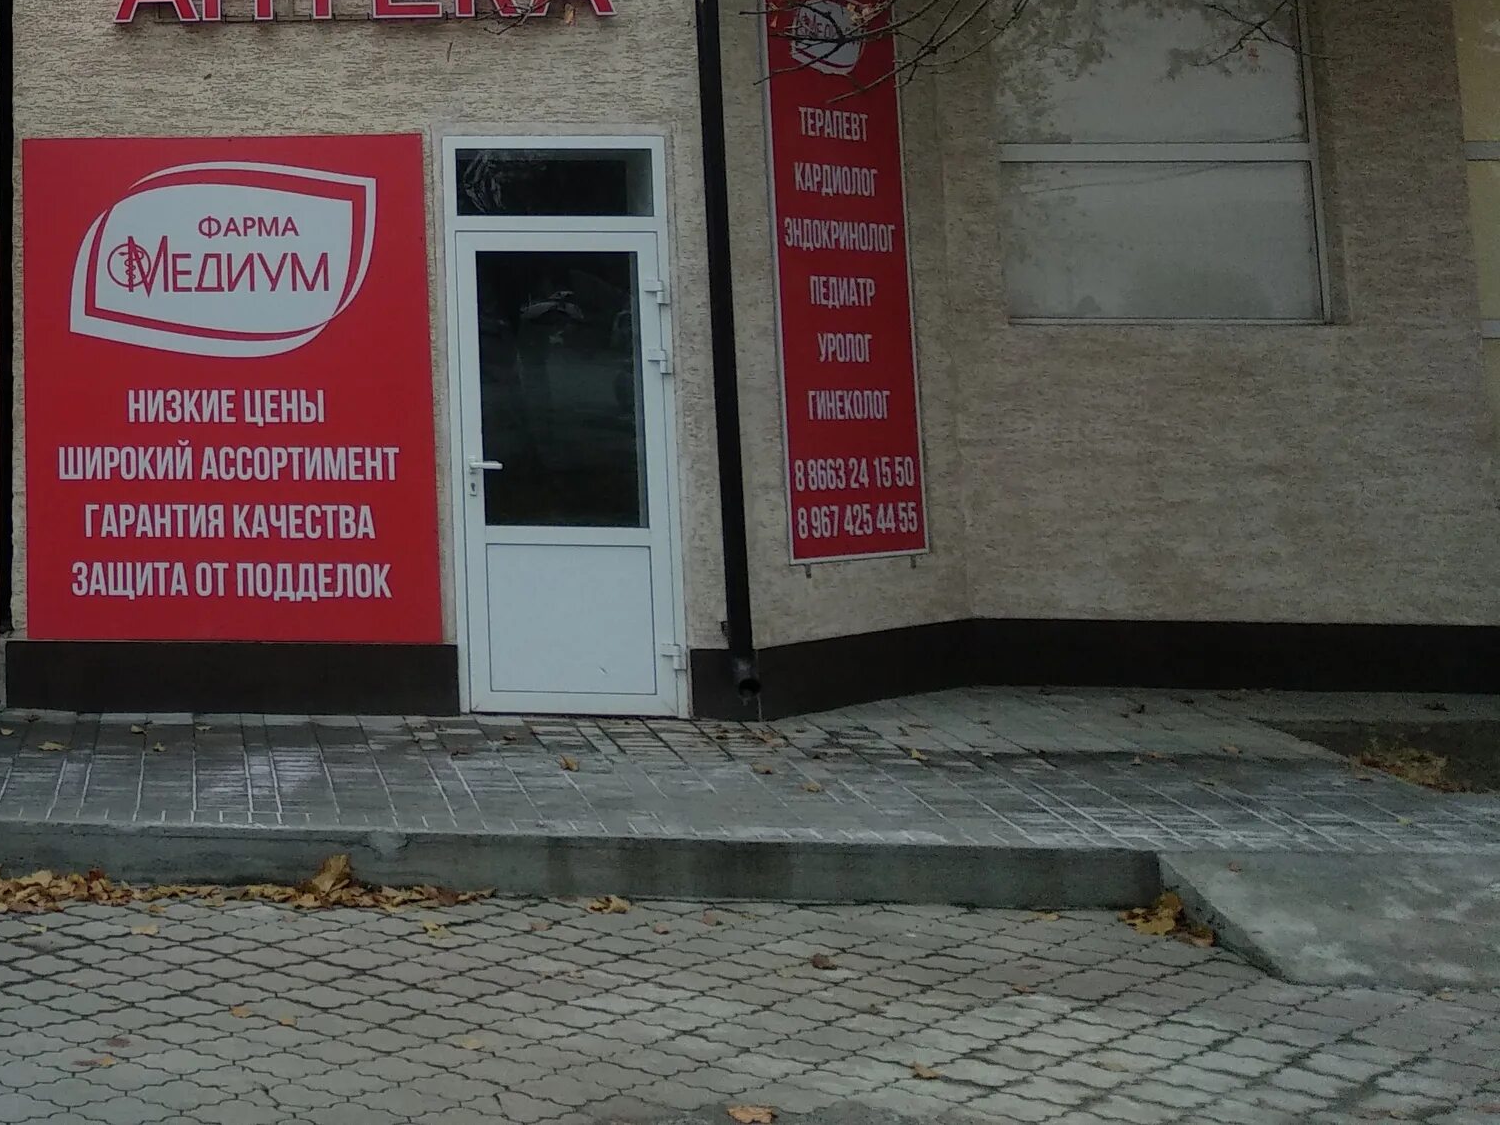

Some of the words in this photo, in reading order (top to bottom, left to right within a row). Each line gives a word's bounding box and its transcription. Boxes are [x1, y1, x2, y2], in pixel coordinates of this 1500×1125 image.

[798, 105, 868, 143] ТЕРАПЕВТ
[794, 161, 878, 198] КАРДИОЛОГ
[198, 215, 299, 239] ФАРМА
[784, 217, 895, 254] ЭНДОКРИНОЛОГ
[809, 276, 876, 309] ПЕДИАТР
[817, 332, 873, 363] УРОЛОГ
[128, 390, 235, 424] НИЗКИЕ
[243, 389, 324, 427] ЦЕНЫ
[808, 389, 891, 421] ГИНЕКОЛОГ
[58, 439, 193, 481] ШИРОКИЙ
[200, 447, 399, 481] АССОРТИМЕНТ
[795, 459, 805, 492] 8
[807, 458, 846, 491] 8663
[849, 457, 869, 489] 24
[873, 457, 892, 488] 15
[894, 456, 915, 487] 50
[85, 505, 225, 540] ГАРАНТИЯ
[233, 505, 375, 540] КАЧЕСТВА
[798, 505, 809, 539] 8
[811, 504, 839, 538] 967
[844, 503, 872, 537] 425
[876, 502, 896, 535] 44
[899, 500, 918, 534] 55
[71, 563, 188, 598] ЗАЩИТА
[196, 562, 229, 596] ОТ
[236, 563, 392, 602] ПОДДЕЛОК
